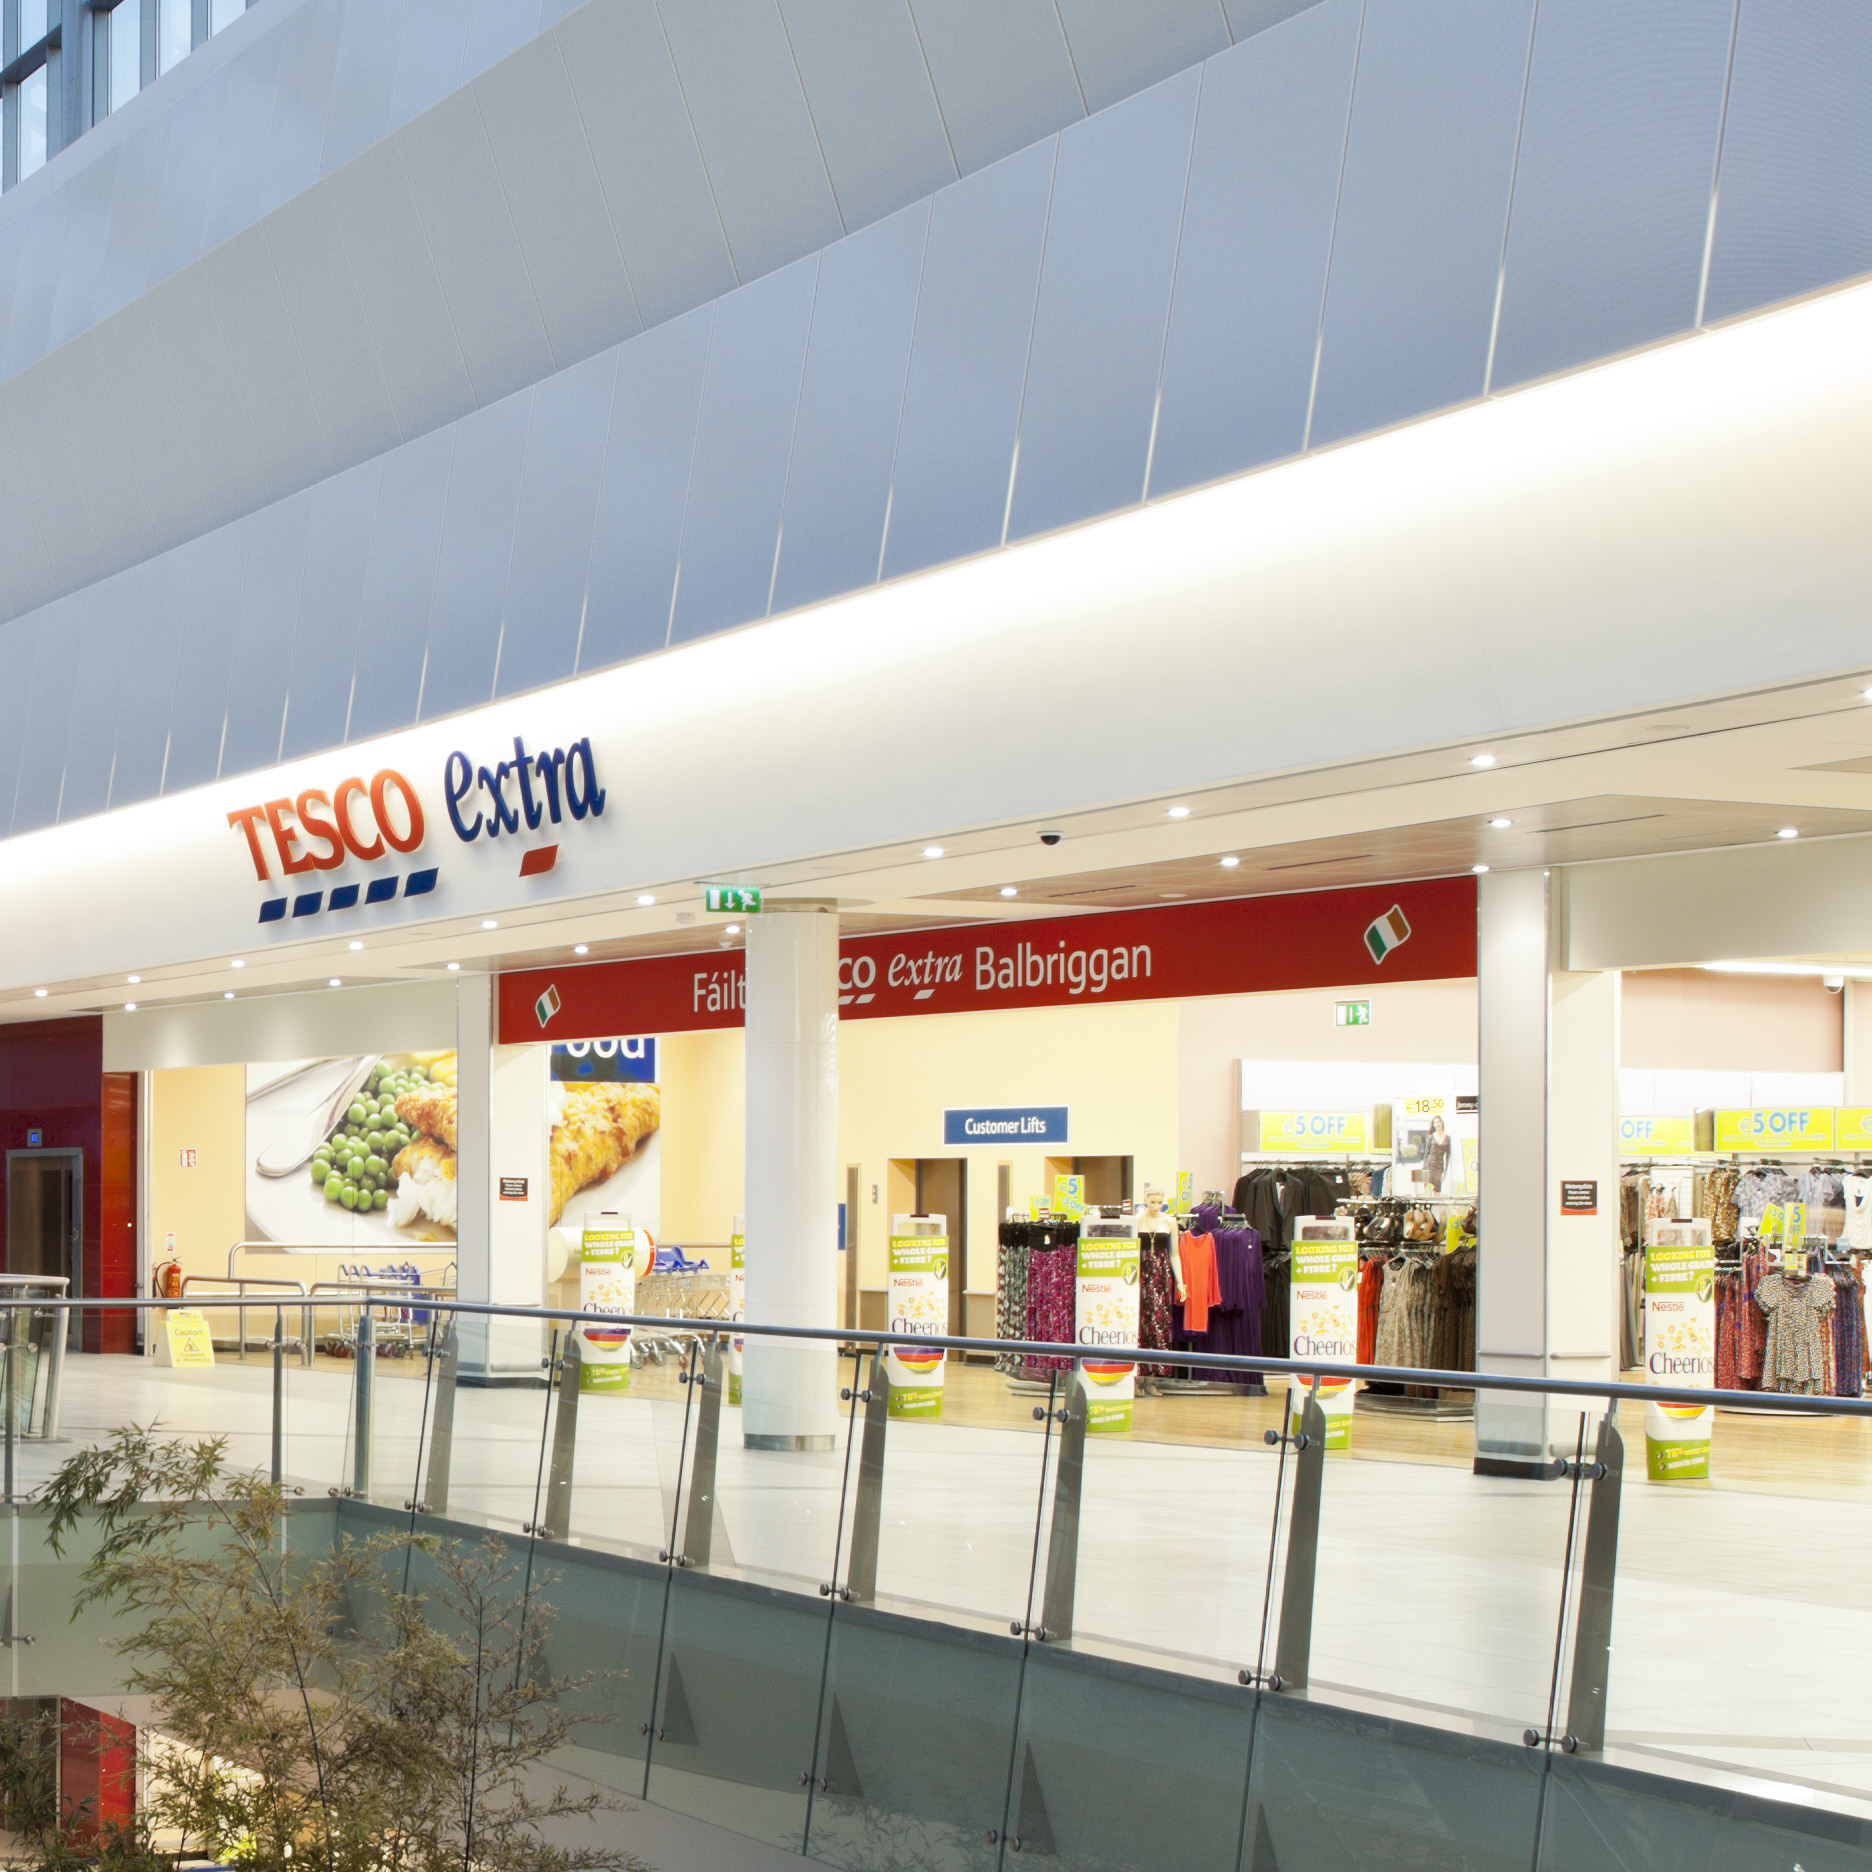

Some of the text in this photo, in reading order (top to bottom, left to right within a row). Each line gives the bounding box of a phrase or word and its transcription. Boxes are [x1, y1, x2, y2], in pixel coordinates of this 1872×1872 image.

[226, 736, 606, 882] TESCO extra
[693, 969, 746, 1013] Fáilt
[887, 950, 963, 987] extra
[975, 940, 1152, 995] Balbriggan
[964, 1116, 1047, 1135] Customer Lifts
[1309, 1115, 1346, 1136] OFF
[1621, 1120, 1655, 1139] OFF
[1768, 1111, 1809, 1134] OFF
[1294, 1335, 1356, 1356] Cheerios
[1650, 1352, 1714, 1375] Cheerios
